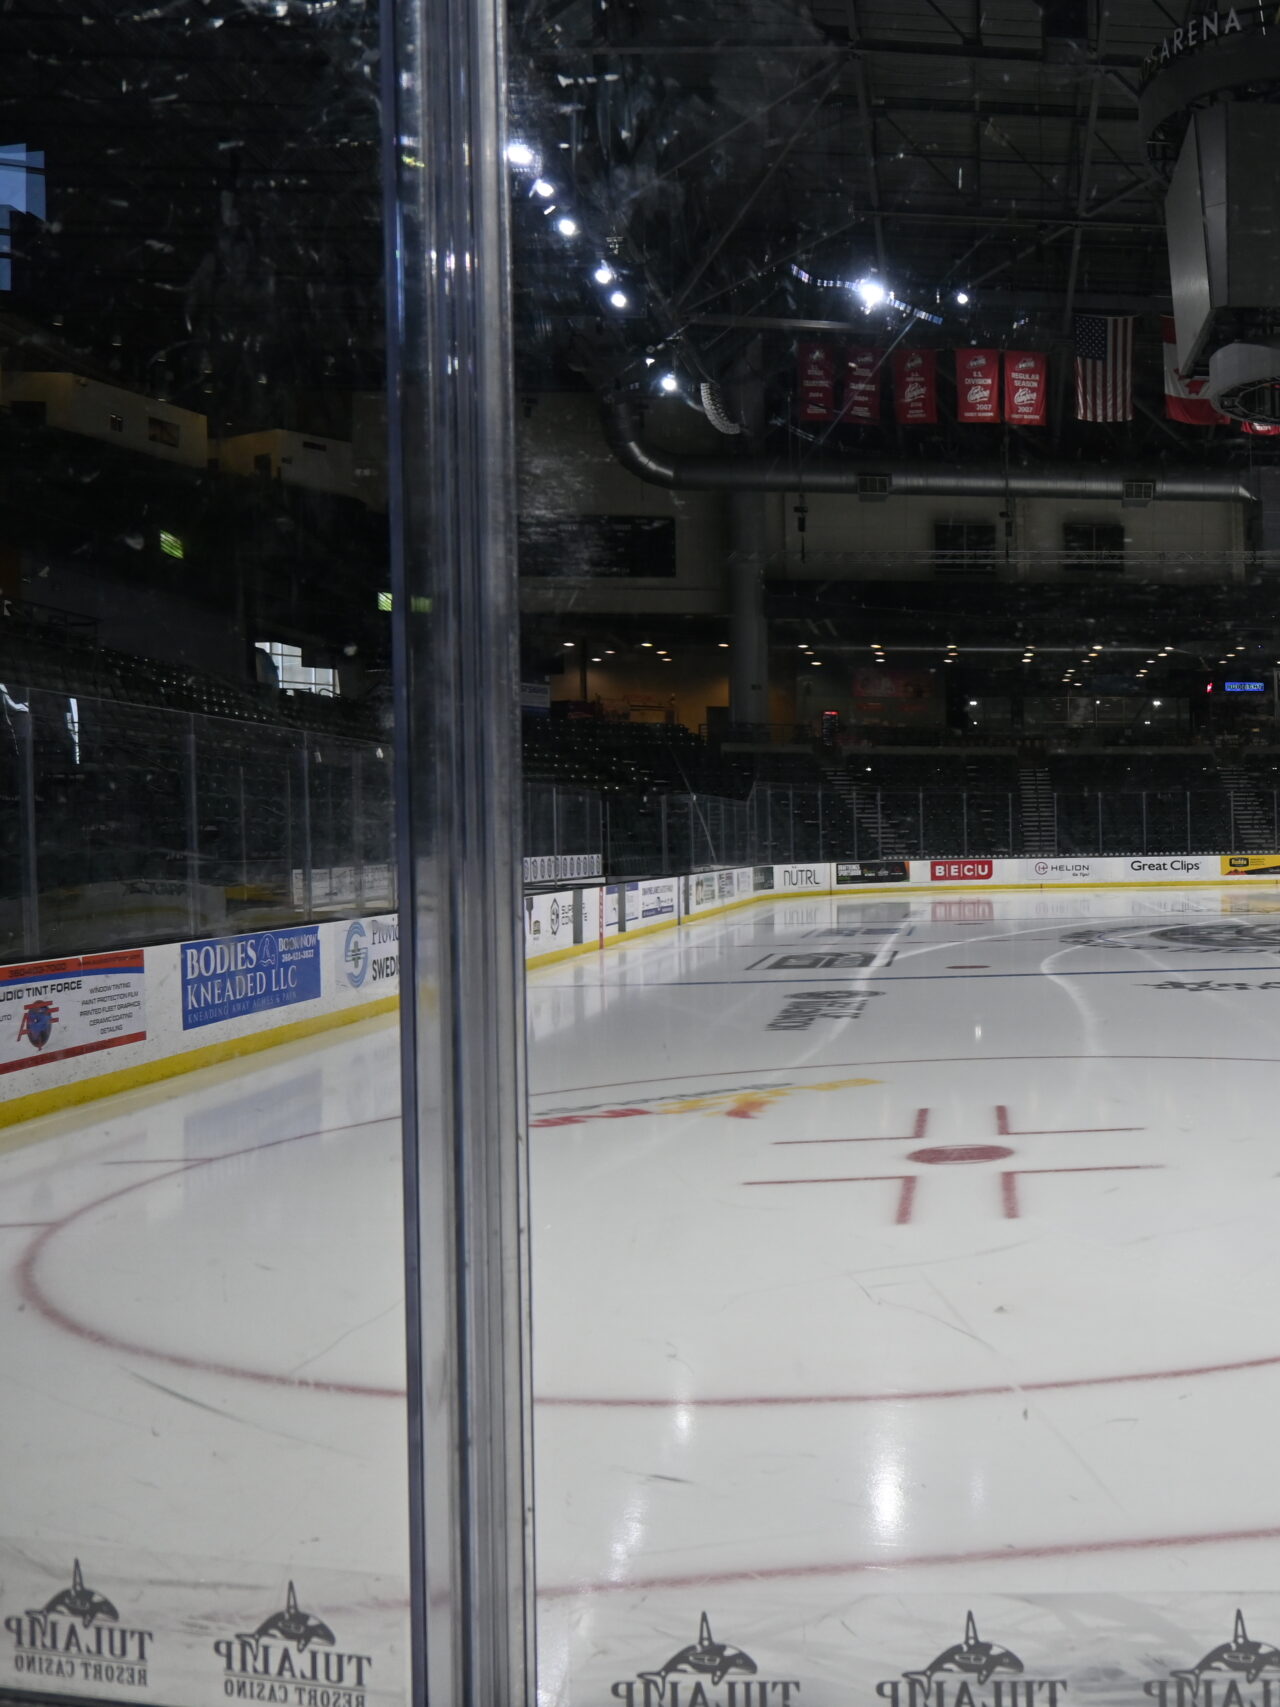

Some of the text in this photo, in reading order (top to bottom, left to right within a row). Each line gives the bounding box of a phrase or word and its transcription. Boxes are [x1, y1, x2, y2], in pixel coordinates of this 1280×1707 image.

[1160, 7, 1242, 64] ARENA
[935, 864, 989, 876] BECU
[1051, 864, 1090, 872] HELION
[1131, 860, 1200, 873] Great Clips
[279, 934, 317, 952] BOOK NOW
[186, 939, 257, 980] BODIES
[372, 955, 400, 981] SWED
[0, 980, 82, 1002] UDIO TINT FORCE
[89, 982, 131, 994] WINDOW TINTING
[187, 965, 297, 1010] KNEADED LLC
[81, 998, 96, 1006] PAINT
[97, 994, 127, 1003] PROTECTION
[80, 1001, 141, 1017] PRINTED FLEET GRAPHICS
[188, 1005, 230, 1024] KNEADING
[232, 1001, 250, 1012] AWAY
[89, 1012, 133, 1026] CERAMIC COATING
[100, 1025, 122, 1035] DETAILING
